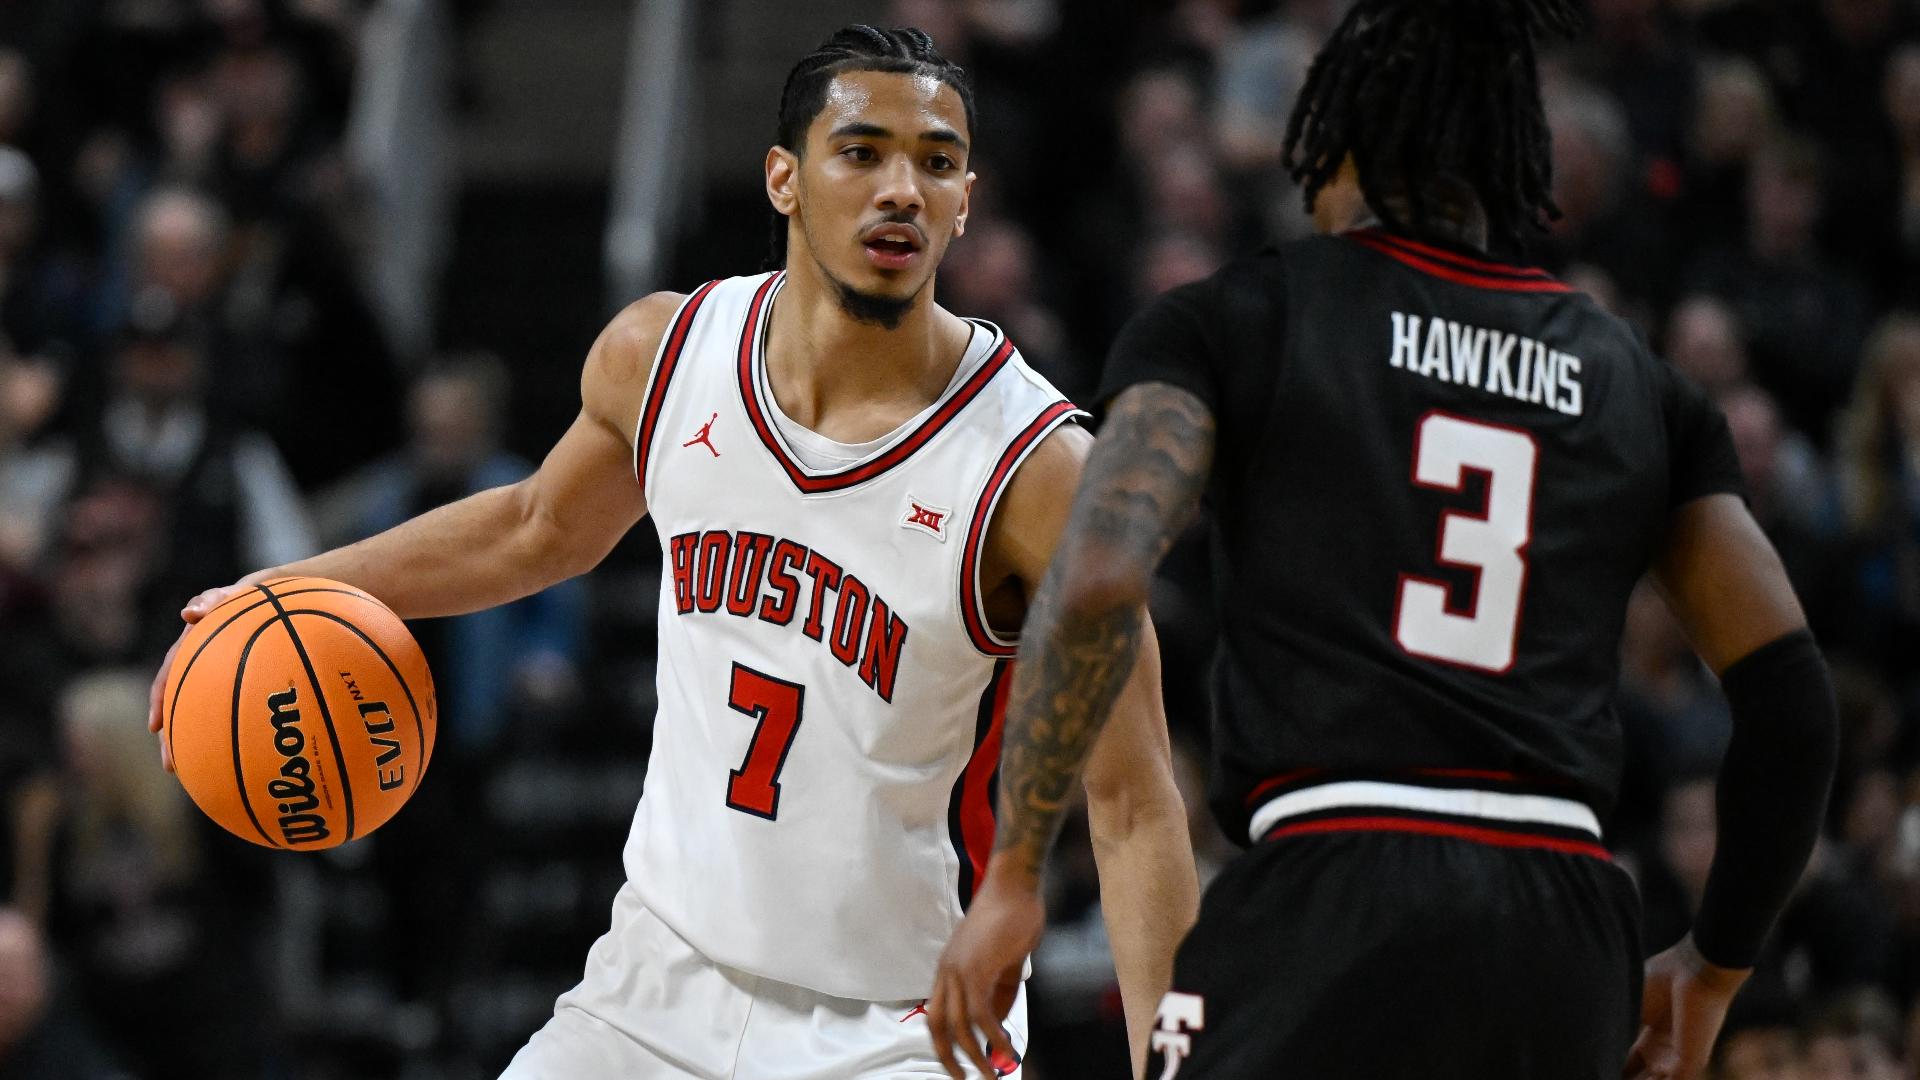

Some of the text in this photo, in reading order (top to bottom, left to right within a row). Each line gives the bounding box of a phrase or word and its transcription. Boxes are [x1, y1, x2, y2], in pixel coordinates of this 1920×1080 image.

[1390, 311, 1582, 416] HAWKINS
[907, 502, 944, 532] XII
[1392, 408, 1540, 675] 3
[339, 671, 364, 700] NXT
[671, 529, 908, 704] HOUSTON
[267, 686, 330, 845] Wilson
[725, 660, 805, 821] 7
